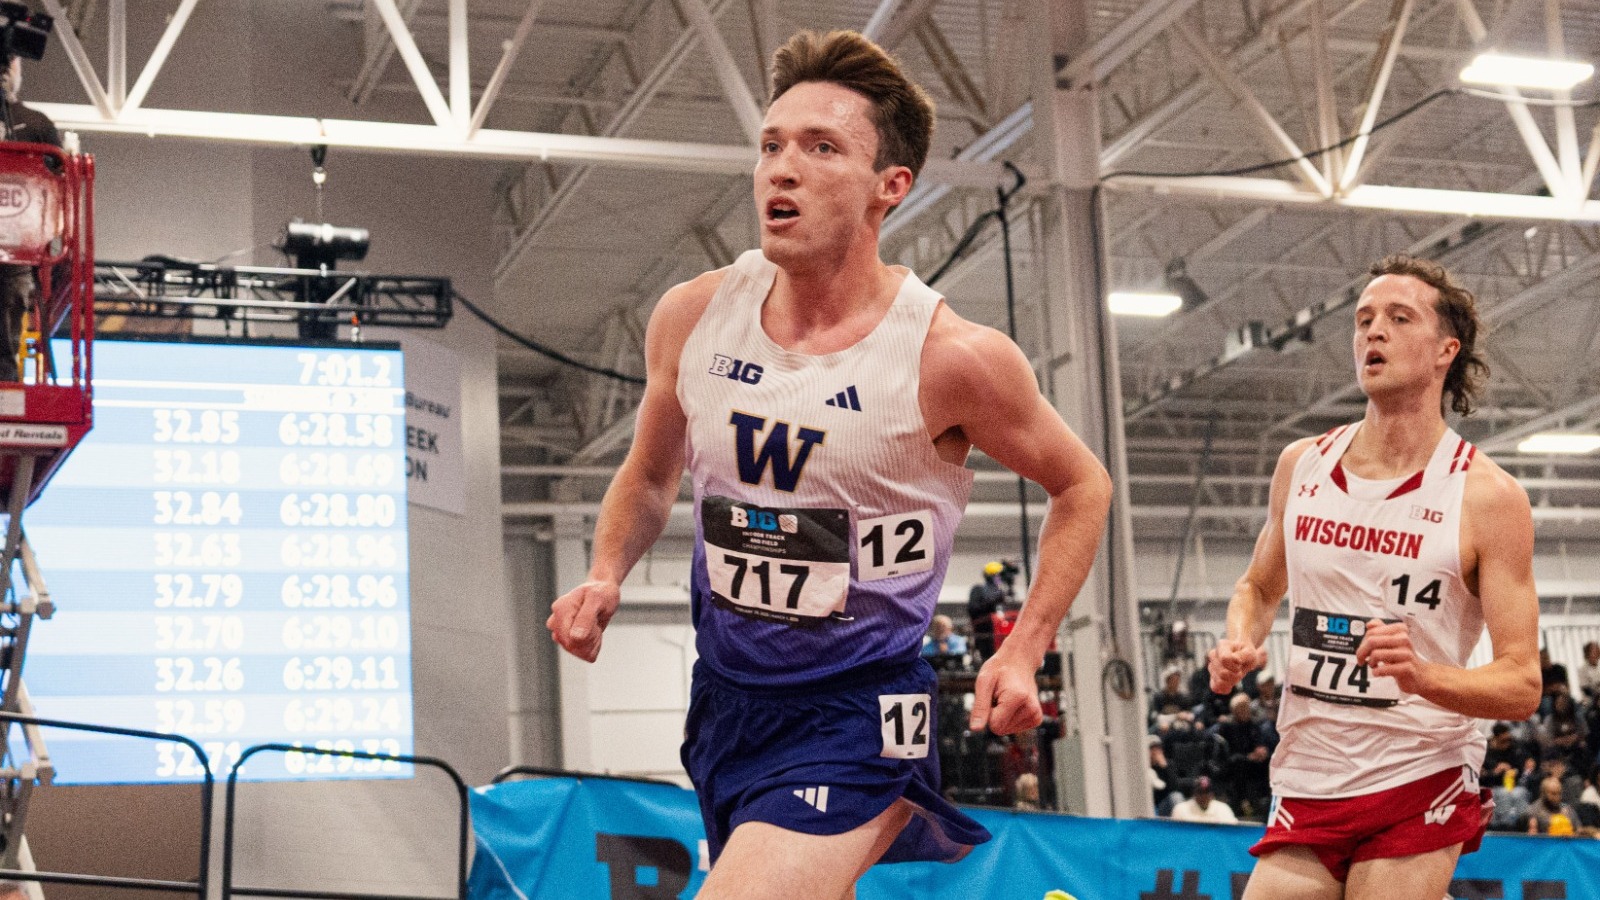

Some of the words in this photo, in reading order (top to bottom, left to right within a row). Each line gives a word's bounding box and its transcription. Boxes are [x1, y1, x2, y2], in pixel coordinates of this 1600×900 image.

[297, 353, 392, 386] 7:01.2
[153, 409, 240, 443] 32.85
[278, 413, 393, 447] 6:28.58
[729, 408, 827, 493] W
[153, 491, 242, 525] 32.84
[280, 494, 396, 527] 6:28.80
[861, 518, 926, 568] 12
[1294, 514, 1424, 560] WISCONSIN
[154, 574, 243, 608] 32.79
[281, 575, 398, 608] 6:28.96
[723, 554, 810, 609] 717
[1391, 573, 1442, 610] 14
[154, 615, 244, 650] 32.70
[282, 615, 399, 650] 6:29.10
[155, 657, 244, 692] 32.26
[283, 656, 400, 691] 6:29.11
[1307, 652, 1371, 694] 774
[155, 699, 246, 734] 32.59
[284, 697, 402, 732] 6:29.24
[884, 701, 927, 746] 12
[1424, 804, 1457, 826] W
